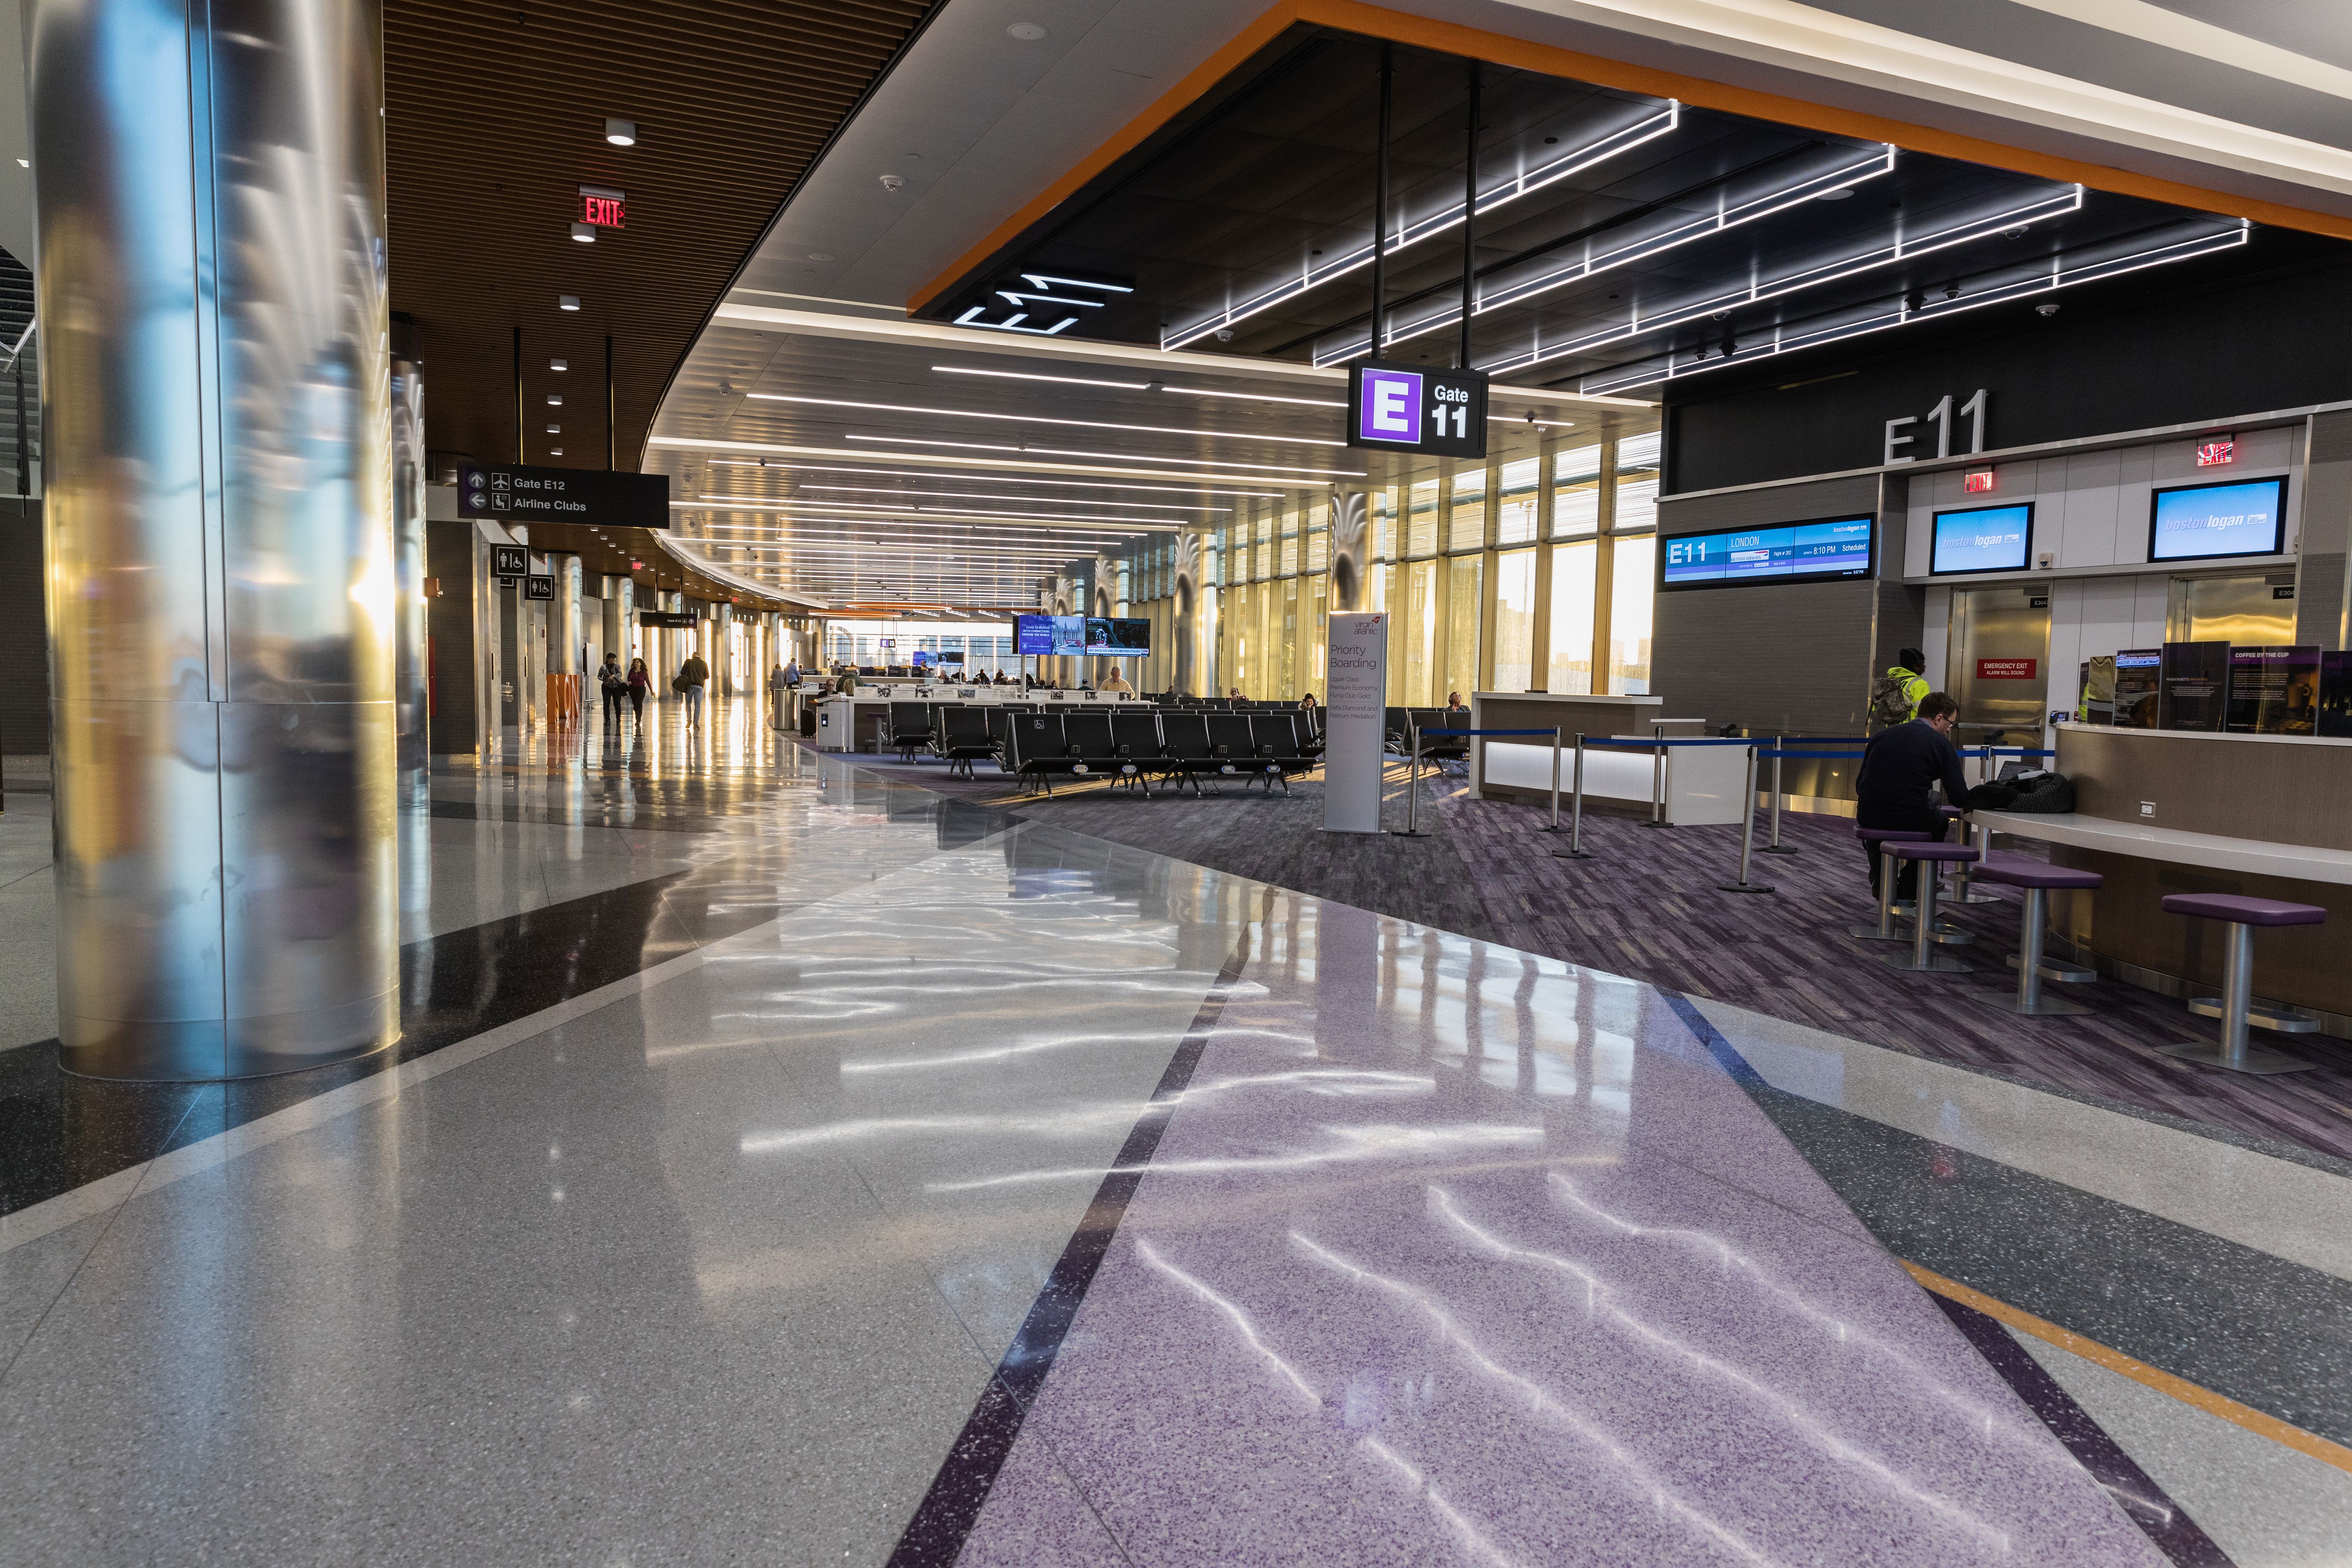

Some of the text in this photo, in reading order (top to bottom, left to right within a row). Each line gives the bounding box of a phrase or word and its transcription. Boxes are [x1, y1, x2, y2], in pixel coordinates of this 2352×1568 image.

[586, 197, 620, 226] EXIT
[1434, 385, 1468, 403] Gate
[1373, 379, 1409, 432] E
[1432, 404, 1466, 438] 11
[1884, 389, 1986, 466] E11
[514, 478, 565, 490] Gate E12
[1969, 473, 1989, 491] EXIT
[514, 498, 586, 511] Airline Clubs
[2165, 515, 2244, 531] bostonlogan
[1731, 536, 1759, 548] LONDON
[1842, 543, 1866, 552] Scheduled
[1942, 535, 2002, 549] bostonlogan
[1670, 542, 1706, 564] E11
[1331, 645, 1366, 656] Priority
[1331, 658, 1376, 670] Boarding
